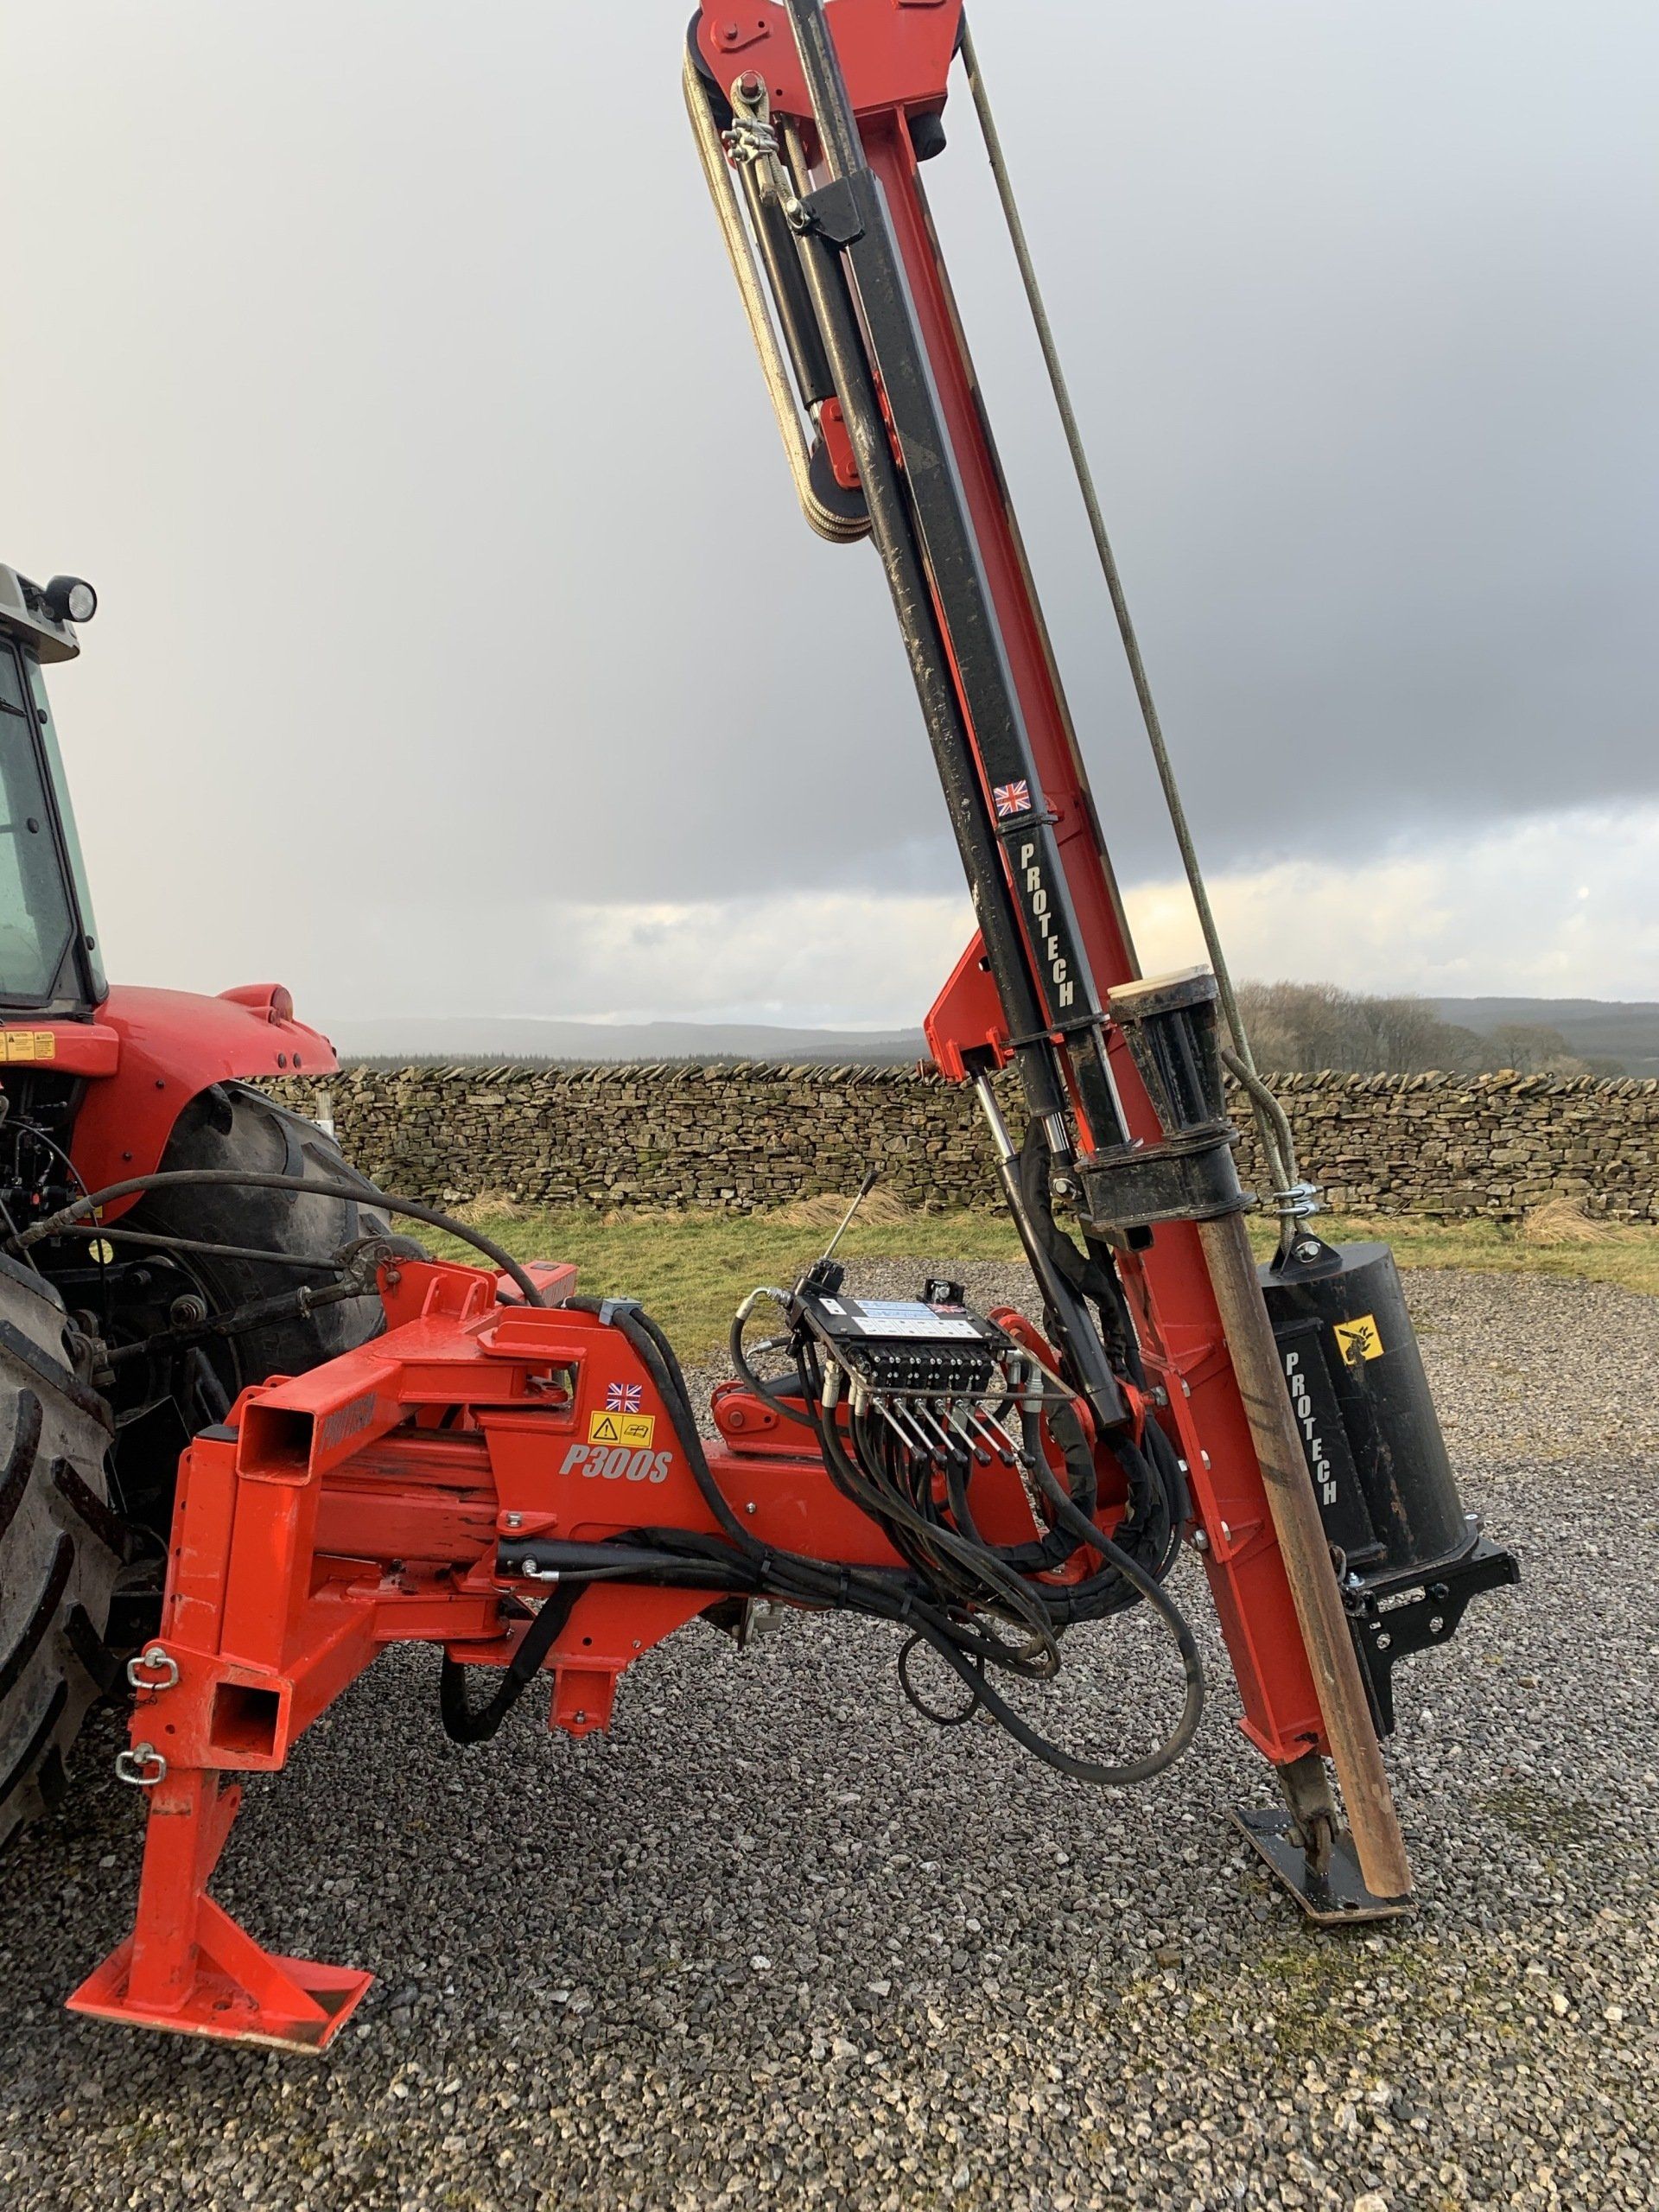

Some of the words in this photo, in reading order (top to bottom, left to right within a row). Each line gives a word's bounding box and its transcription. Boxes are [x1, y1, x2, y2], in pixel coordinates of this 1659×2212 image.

[1020, 842, 1074, 1007] PROTECH
[559, 1445, 673, 1484] P300S
[1286, 1351, 1337, 1505] PROTECH
